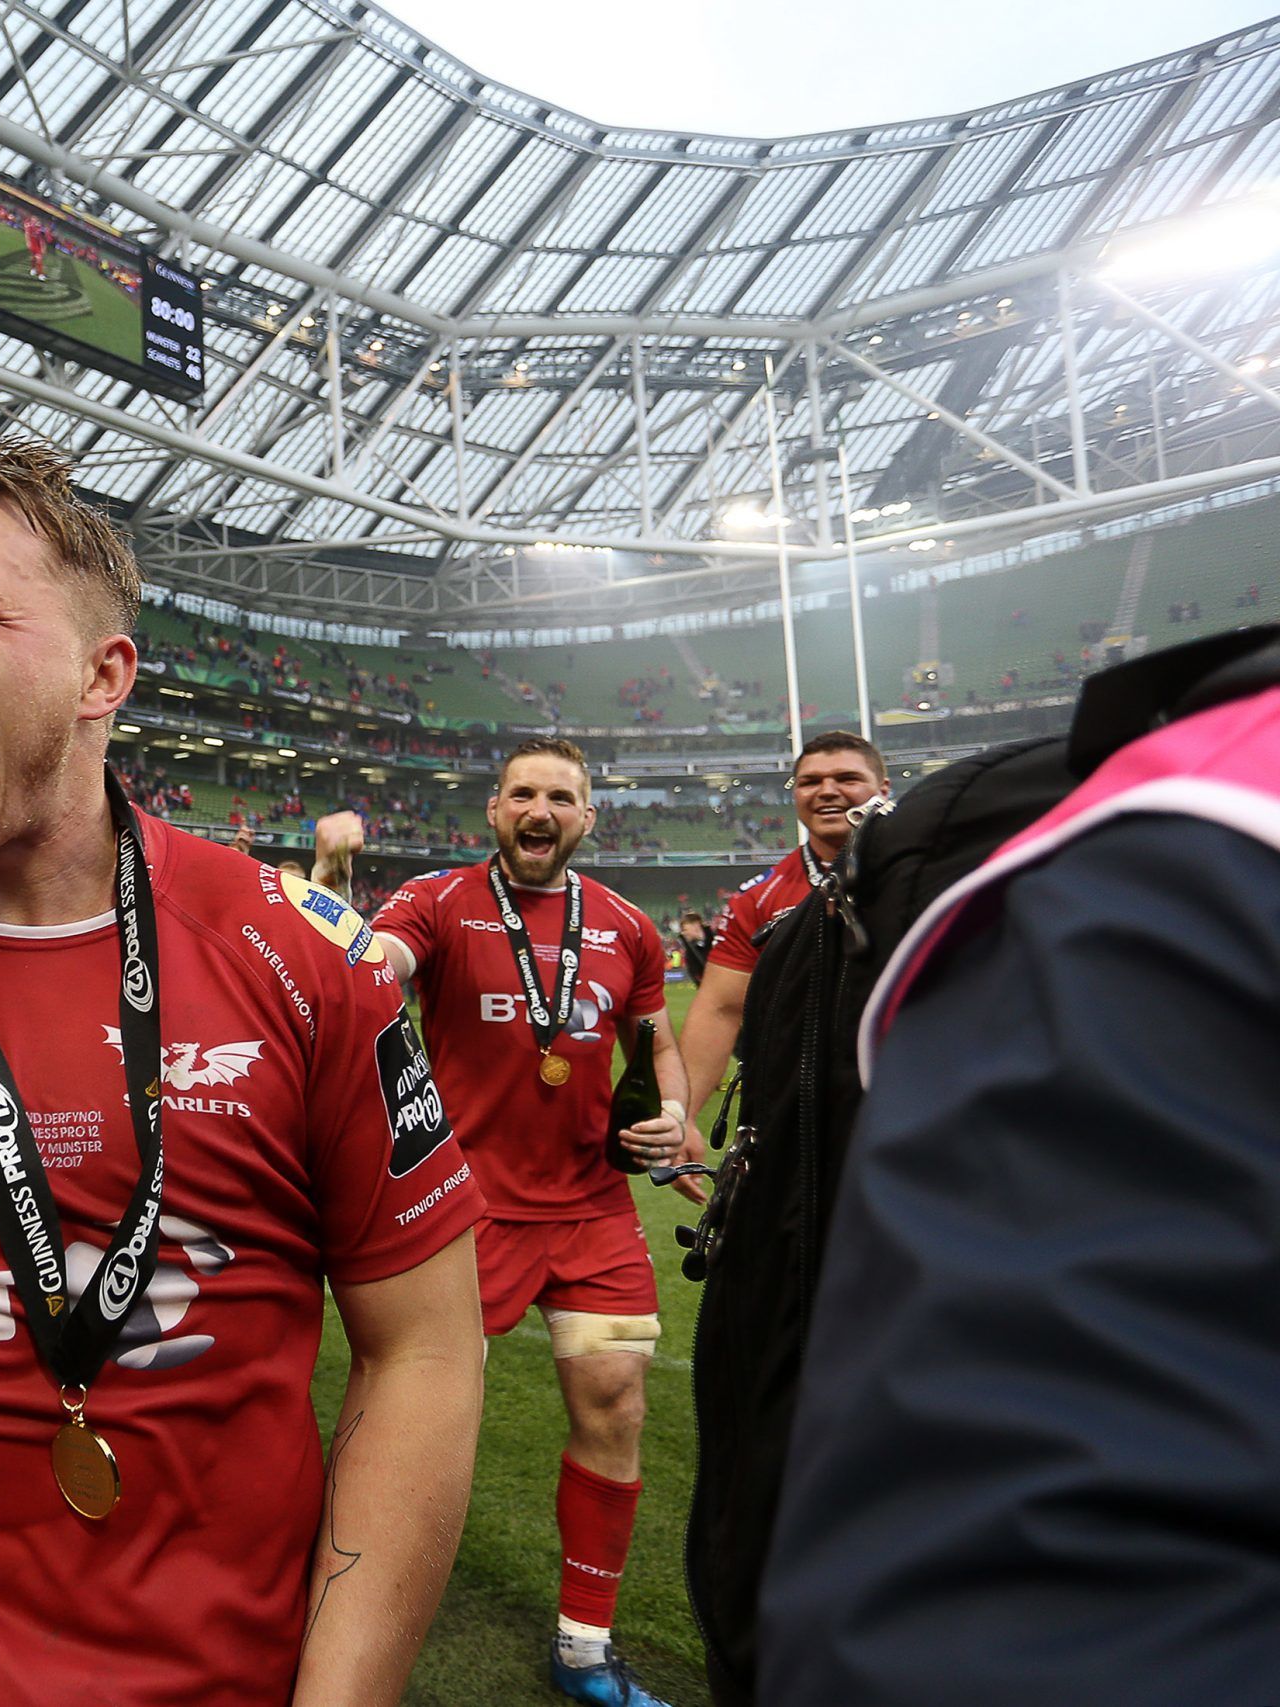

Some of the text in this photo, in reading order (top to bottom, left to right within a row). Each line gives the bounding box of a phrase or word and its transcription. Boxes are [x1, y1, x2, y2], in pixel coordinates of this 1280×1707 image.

[151, 296, 195, 331] 80:00
[120, 829, 154, 1013] GUINNESS PRO12
[241, 924, 295, 992] GRAVELLS
[43, 1110, 105, 1125] DERFYNOL
[60, 1125, 86, 1139] PRO
[88, 1125, 100, 1138] 12
[394, 1079, 443, 1140] PRO12
[35, 1140, 103, 1154] V MUNSTER
[395, 1186, 443, 1227] TANIO'R
[8, 1184, 63, 1293] GUINNESS
[99, 1199, 160, 1321] PRO12
